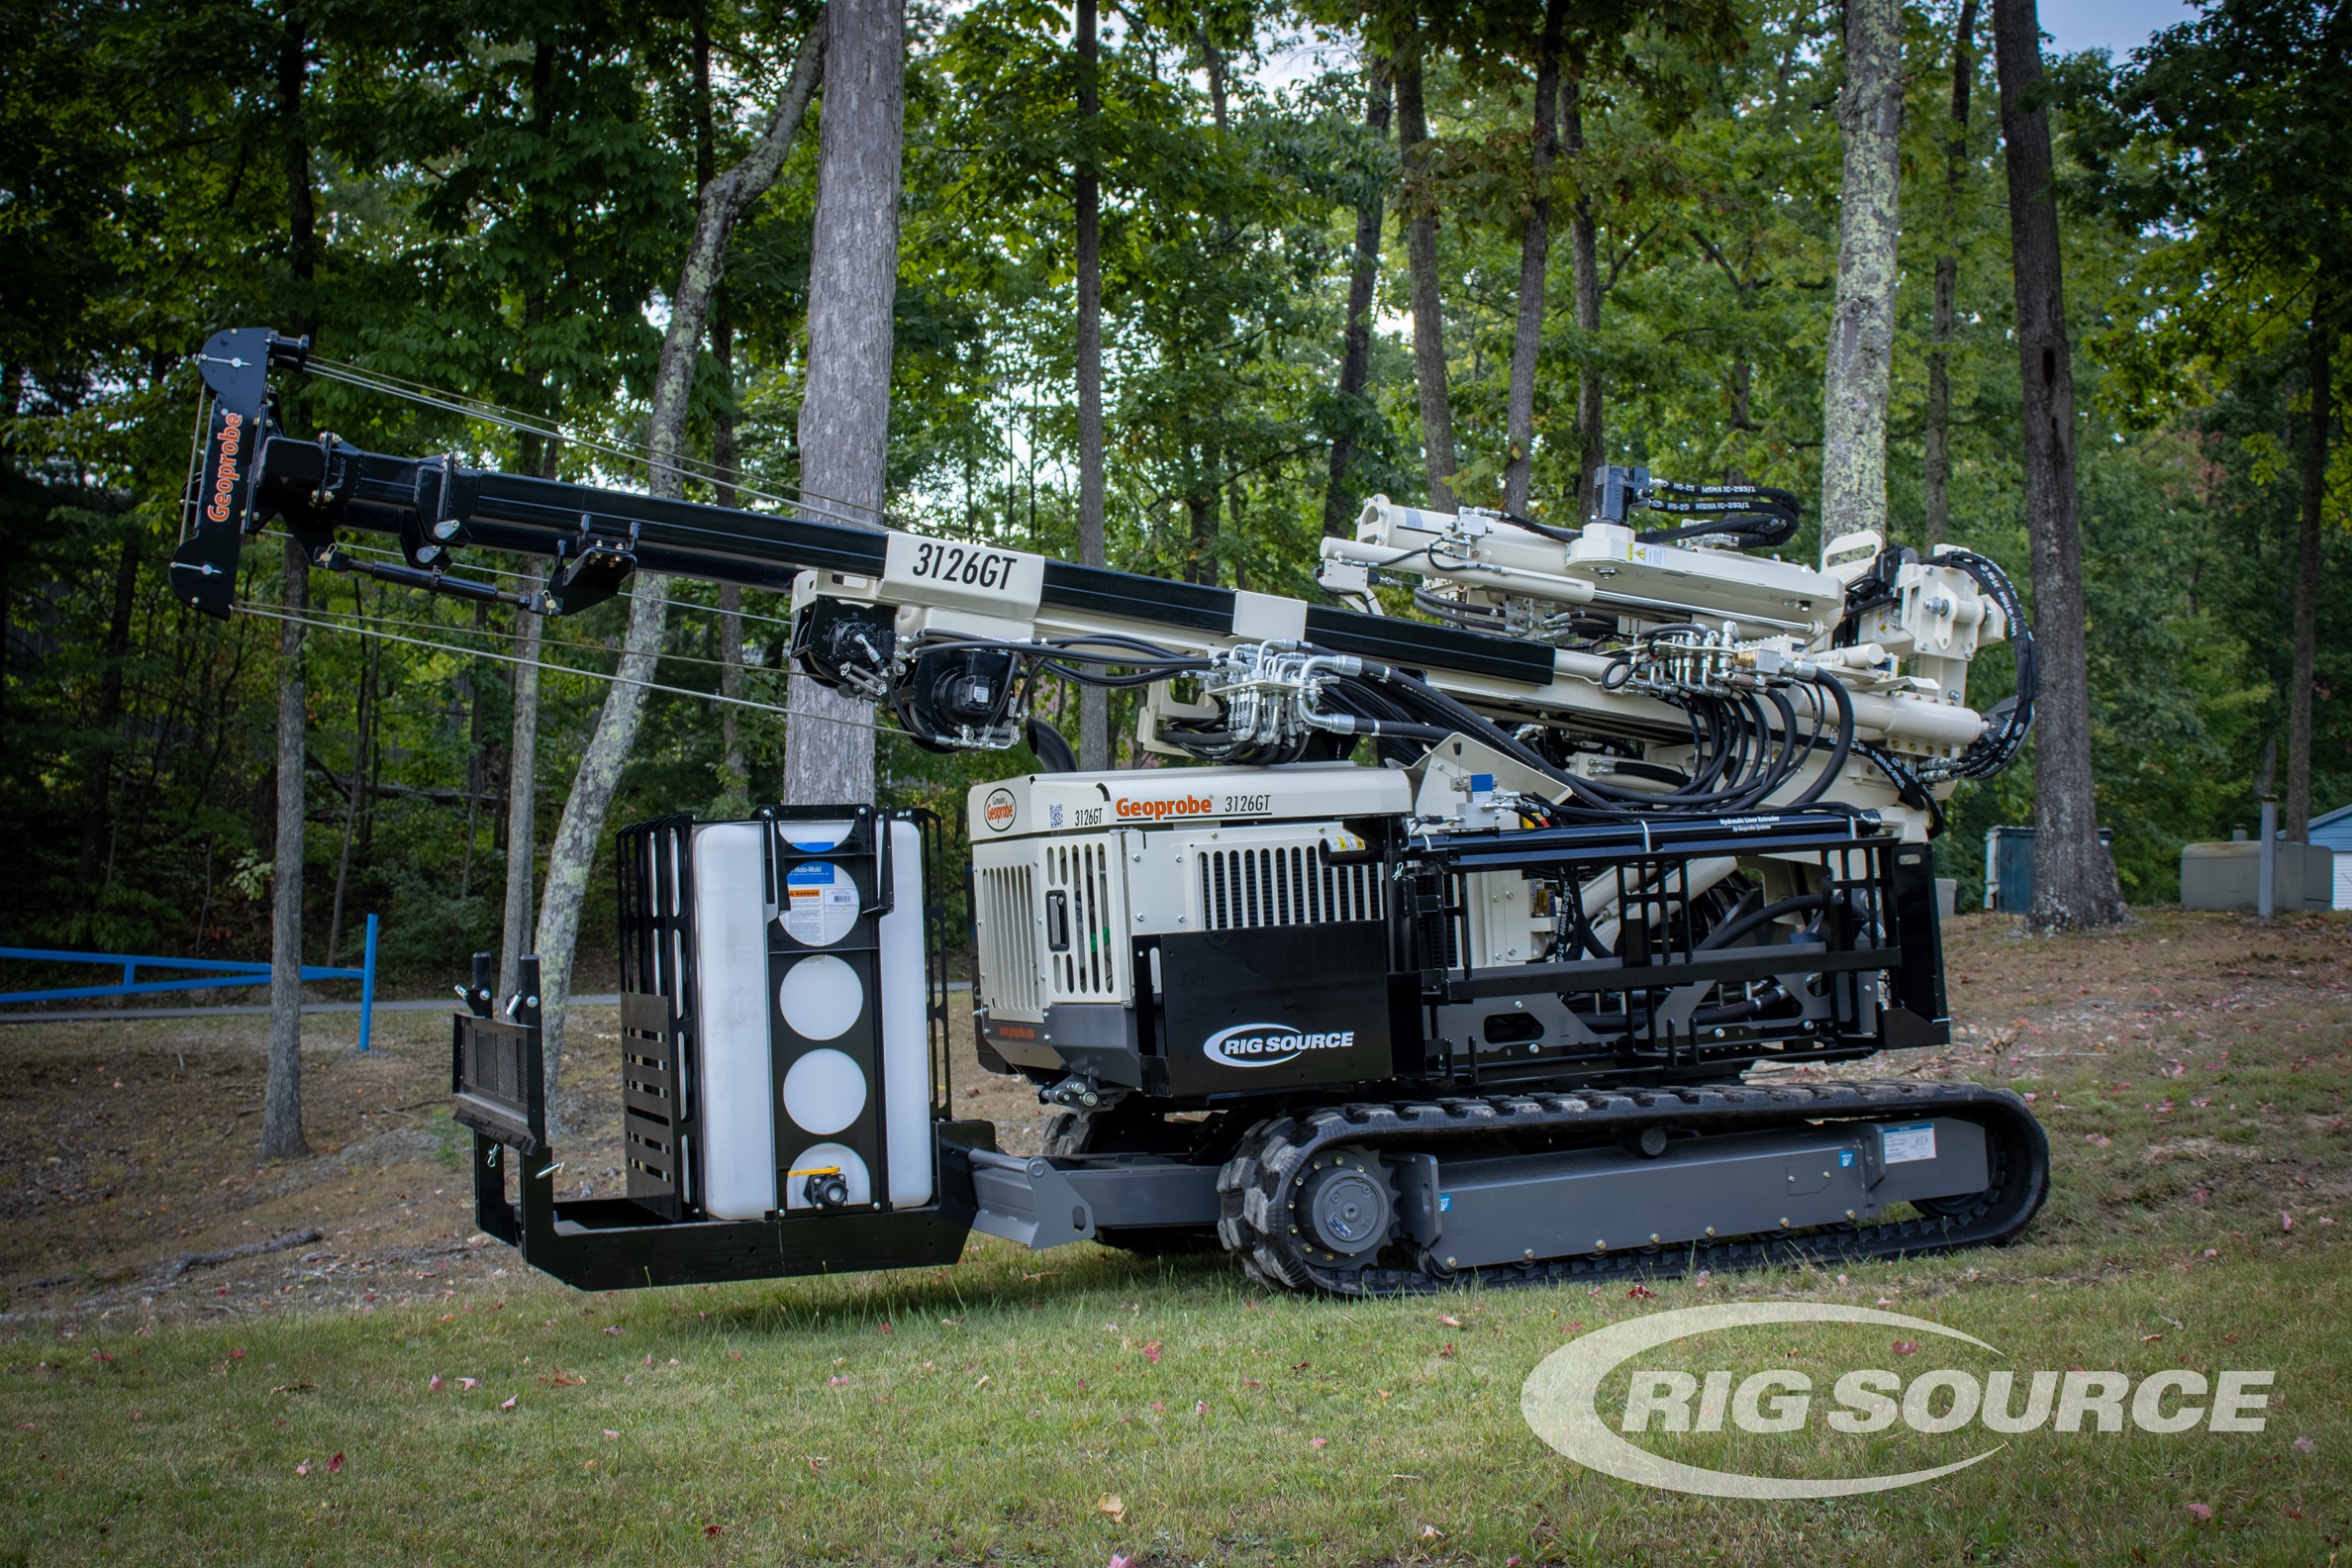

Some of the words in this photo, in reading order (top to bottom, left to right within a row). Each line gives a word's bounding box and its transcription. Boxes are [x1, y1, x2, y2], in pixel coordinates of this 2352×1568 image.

[207, 412, 243, 523] Geoprobe
[913, 542, 1018, 590] 3126GT
[986, 801, 1014, 824] Geoprobe
[1075, 808, 1103, 827] 3126GT
[1116, 795, 1213, 821] Geoprobe
[1225, 795, 1271, 813] 3126GT
[1224, 1037, 1263, 1055] RIG
[1265, 1031, 1354, 1052] SOURCE
